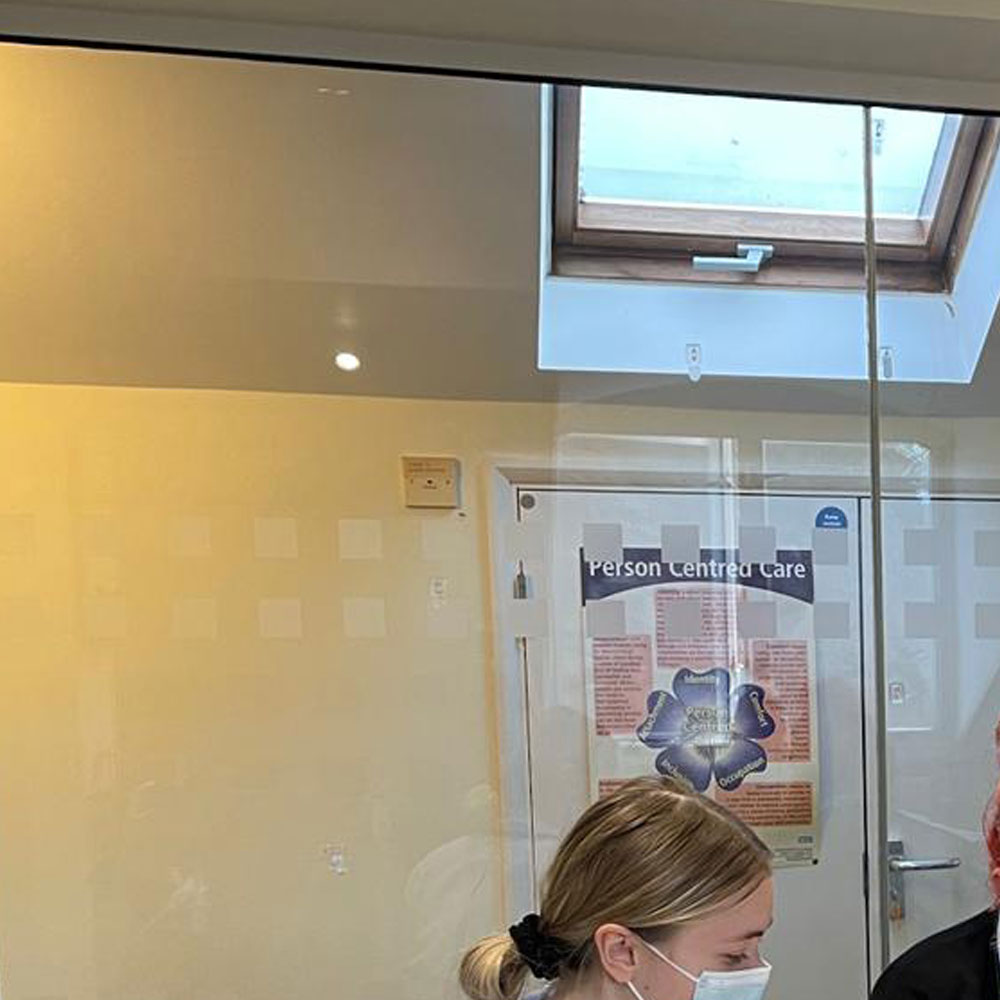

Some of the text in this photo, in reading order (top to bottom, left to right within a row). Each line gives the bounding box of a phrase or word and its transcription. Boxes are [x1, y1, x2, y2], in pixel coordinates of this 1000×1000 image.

[589, 561, 806, 579] Person Centred Care
